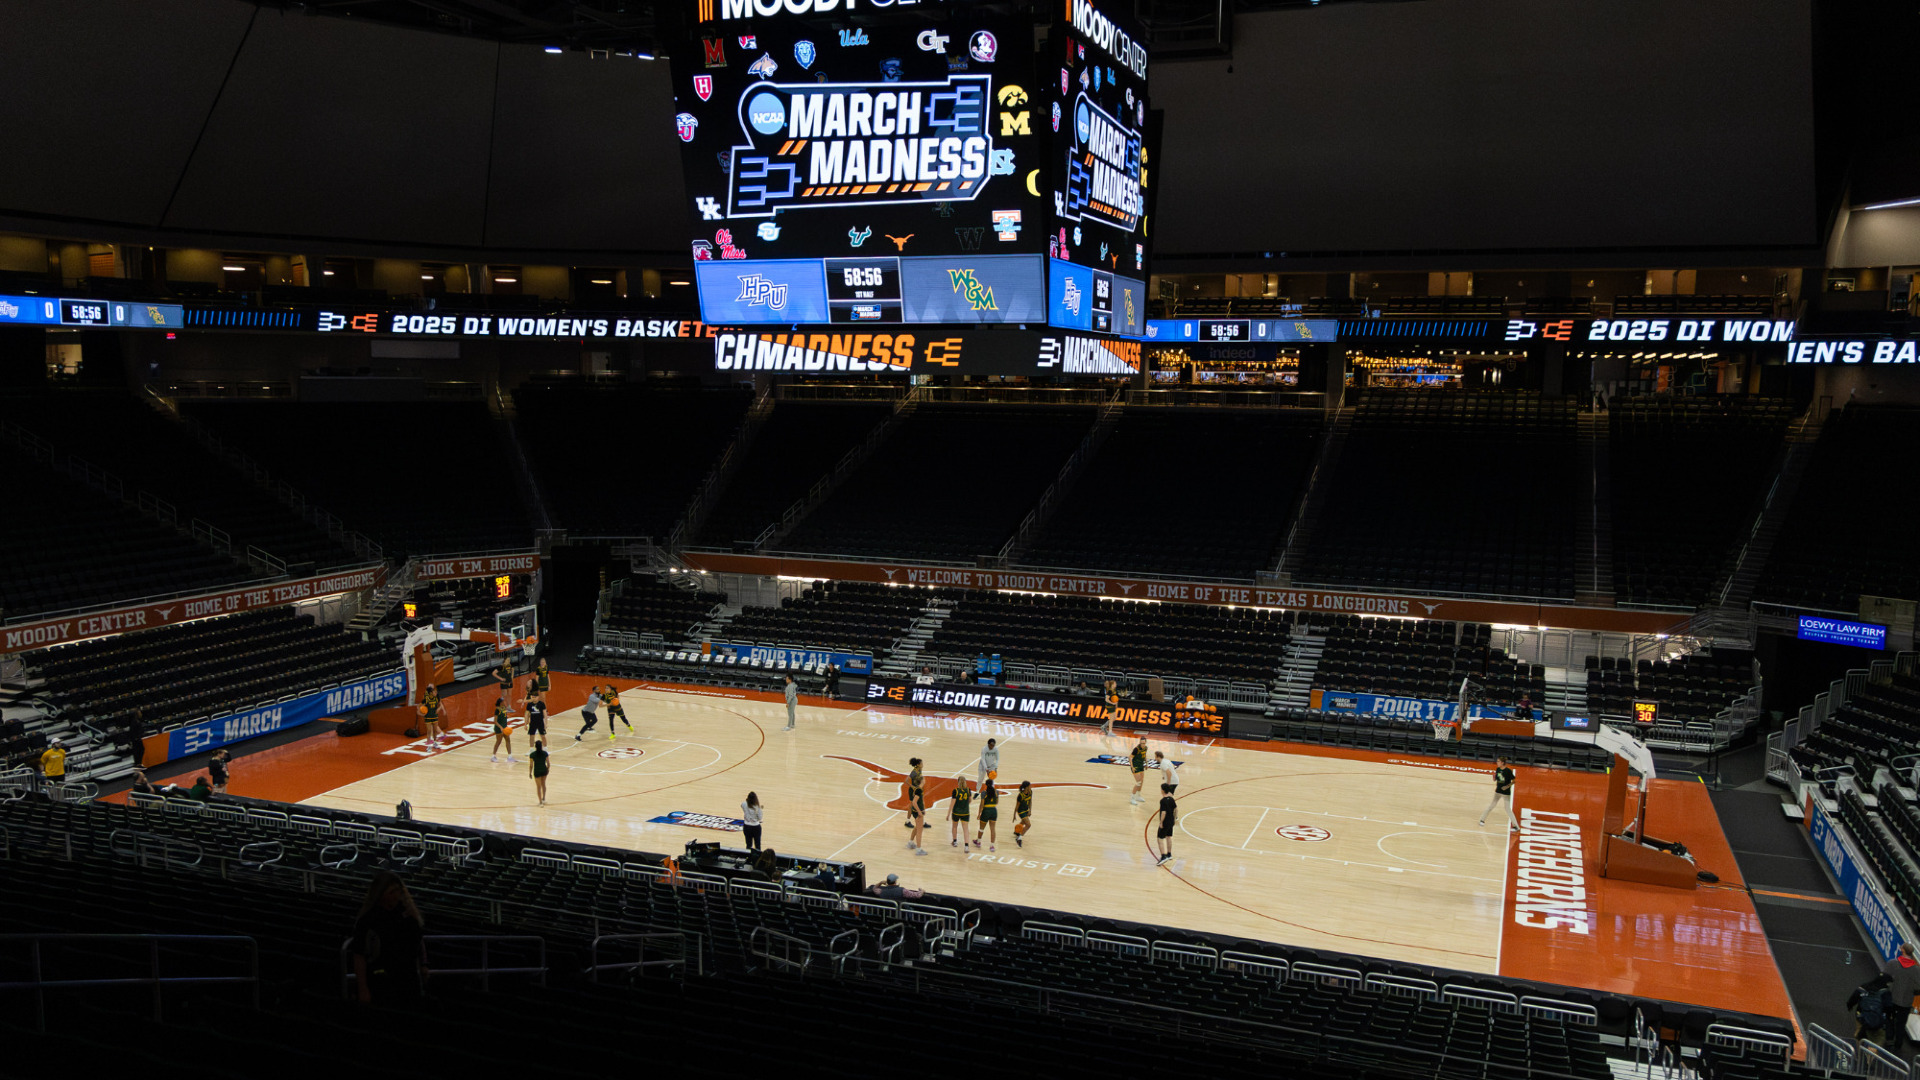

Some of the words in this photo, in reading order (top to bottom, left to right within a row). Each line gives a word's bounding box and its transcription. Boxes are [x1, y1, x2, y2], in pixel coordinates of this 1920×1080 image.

[722, 0, 856, 20] MOO
[1073, 0, 1115, 55] MOODY
[1114, 28, 1147, 80] CENTER
[704, 38, 725, 64] M
[753, 112, 784, 124] NCAA
[789, 92, 921, 138] MARCH
[1000, 111, 1031, 136] M
[1088, 111, 1126, 171] MARCH
[809, 137, 986, 185] MADNESS
[1092, 158, 1139, 216] MADNESS
[715, 229, 732, 244] Ole
[720, 245, 747, 259] Miss
[844, 267, 883, 287] 58:56
[735, 273, 789, 310] HPU
[946, 268, 999, 311] W&M
[45, 301, 54, 319] 0
[72, 305, 102, 320] 58:56
[116, 305, 124, 321] 0
[392, 315, 456, 333] 2025
[463, 317, 491, 334] DI
[498, 318, 607, 337] WOMEN'S
[615, 320, 720, 338] BASKETB
[1184, 323, 1192, 337] 0
[1211, 325, 1239, 336] 58:56
[1258, 323, 1266, 337] 0
[1588, 320, 1669, 341] 2025
[1676, 320, 1721, 341] DI
[715, 334, 916, 371] CHMADNESS
[1209, 346, 1256, 359] indeed
[1872, 341, 1920, 363] BA
[490, 557, 534, 571] HORNS
[497, 583, 509, 598] 30
[907, 569, 973, 587] WELCOME
[976, 573, 993, 587] TO
[999, 574, 1045, 590] MOODY
[1050, 578, 1106, 594] CENTER
[185, 601, 222, 617] HOME
[226, 595, 241, 610] OF
[245, 590, 270, 607] THE
[273, 582, 311, 601] TEXAS
[314, 572, 375, 595] LONGHORNS
[1147, 584, 1189, 600] HOME
[1194, 587, 1213, 602] OF
[1219, 588, 1250, 605] THE
[1256, 590, 1307, 608] TEXAS
[1313, 595, 1409, 614] LONGHORNS
[6, 622, 70, 648] MOODY
[78, 611, 146, 637] CENTER
[1800, 619, 1835, 631] LOEWY
[1837, 624, 1860, 634] LAW
[1862, 627, 1885, 637] FIRM
[750, 647, 788, 666] FOUR
[223, 708, 282, 742] MARCH
[326, 676, 402, 714] MADNESS
[912, 688, 991, 708] WELCOME
[994, 696, 1016, 710] TO
[1020, 699, 1082, 717] MARCH
[1373, 697, 1422, 719] FOUR
[1426, 701, 1450, 721] IT
[1635, 703, 1656, 712] 58:56
[1639, 711, 1652, 722] 30
[837, 729, 900, 740] TRUIST
[1387, 758, 1497, 774] @TexasLonghorn
[958, 793, 968, 801] 24
[967, 853, 1057, 870] TRUIST
[1514, 807, 1589, 935] LONGHORNS
[1823, 828, 1845, 878] MARCH
[1853, 877, 1894, 959] MADNESS
